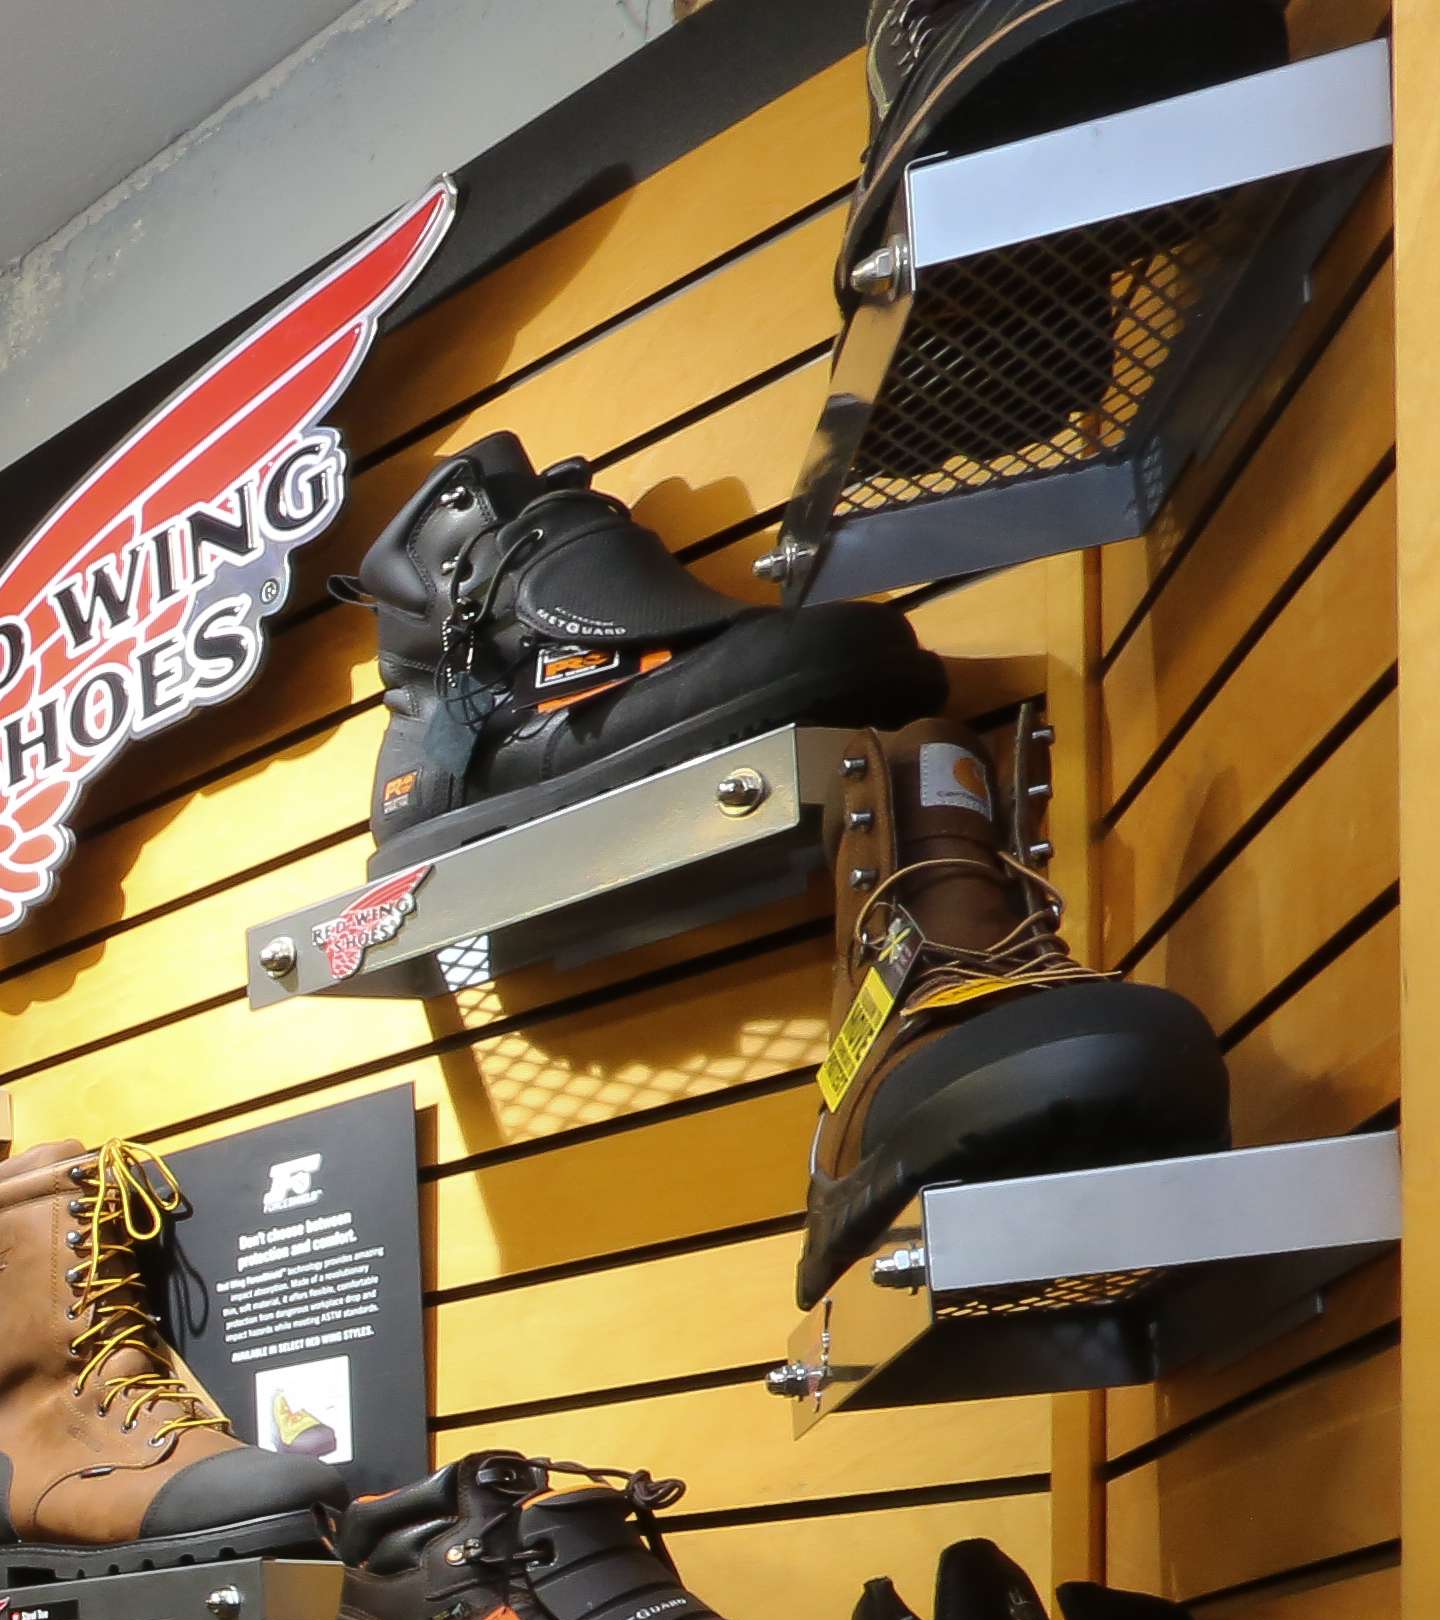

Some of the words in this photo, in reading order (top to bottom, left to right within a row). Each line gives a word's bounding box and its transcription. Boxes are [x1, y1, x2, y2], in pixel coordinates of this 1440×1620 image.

[53, 443, 329, 650] WING
[313, 921, 345, 943] RED
[356, 898, 408, 925] WING
[334, 926, 389, 952] SHOES
[305, 1212, 352, 1233] between
[238, 1246, 289, 1271] protection
[291, 1239, 310, 1255] and
[279, 1339, 304, 1353] SELECT
